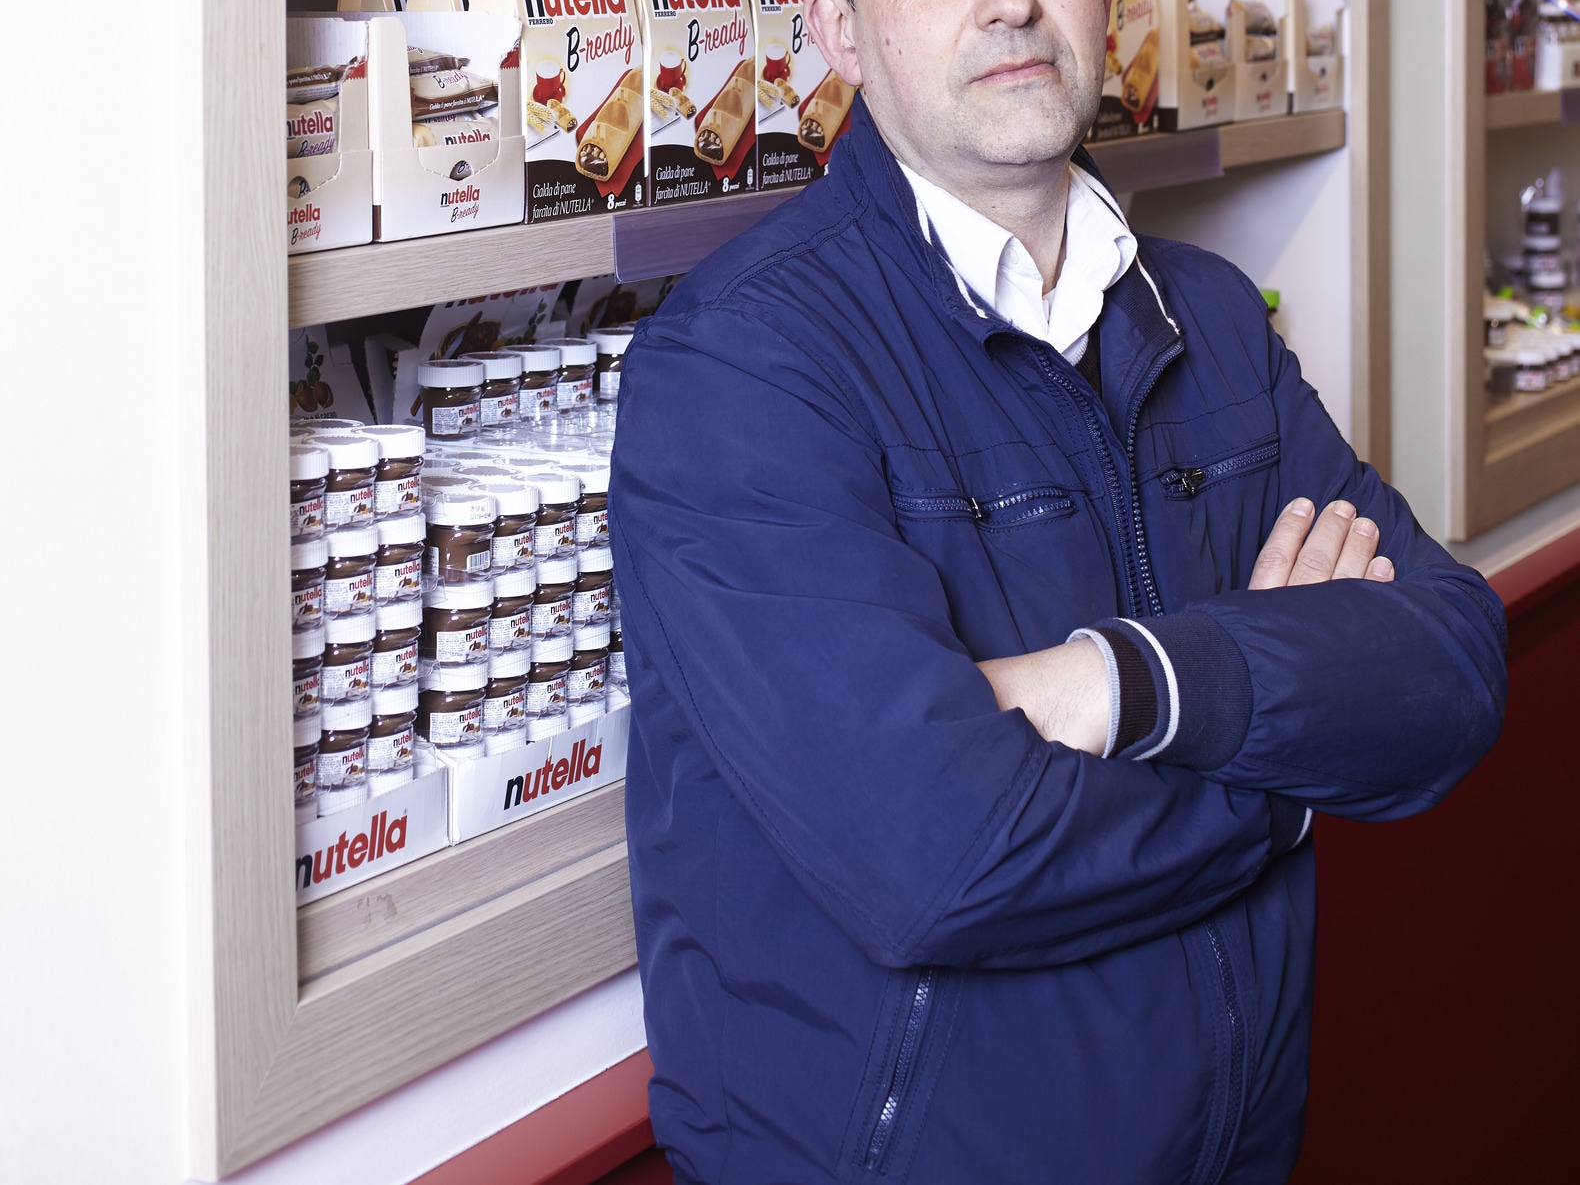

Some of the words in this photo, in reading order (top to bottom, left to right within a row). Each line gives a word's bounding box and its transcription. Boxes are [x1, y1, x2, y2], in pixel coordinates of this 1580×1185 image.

[528, 18, 554, 26] FERRERO
[655, 10, 677, 18] FERRERO
[566, 15, 635, 73] B-ready
[687, 9, 748, 62] B-ready
[762, 152, 780, 167] Cialda
[779, 150, 785, 165] di
[785, 153, 799, 168] pane
[655, 166, 674, 181] Cialda
[674, 164, 680, 179] di
[680, 166, 695, 182] pane
[760, 171, 779, 189] farcita
[779, 169, 785, 184] di
[532, 182, 553, 199] Cialda
[553, 181, 560, 196] di
[559, 183, 577, 199] pane
[653, 186, 674, 205] farcita
[673, 183, 680, 198] di
[722, 176, 729, 193] 8
[440, 184, 481, 206] nutella
[606, 193, 615, 210] 8
[287, 203, 321, 225] utella
[530, 203, 552, 224] farcita
[552, 201, 560, 216] di
[594, 512, 608, 523] nute
[503, 738, 603, 811] nutella
